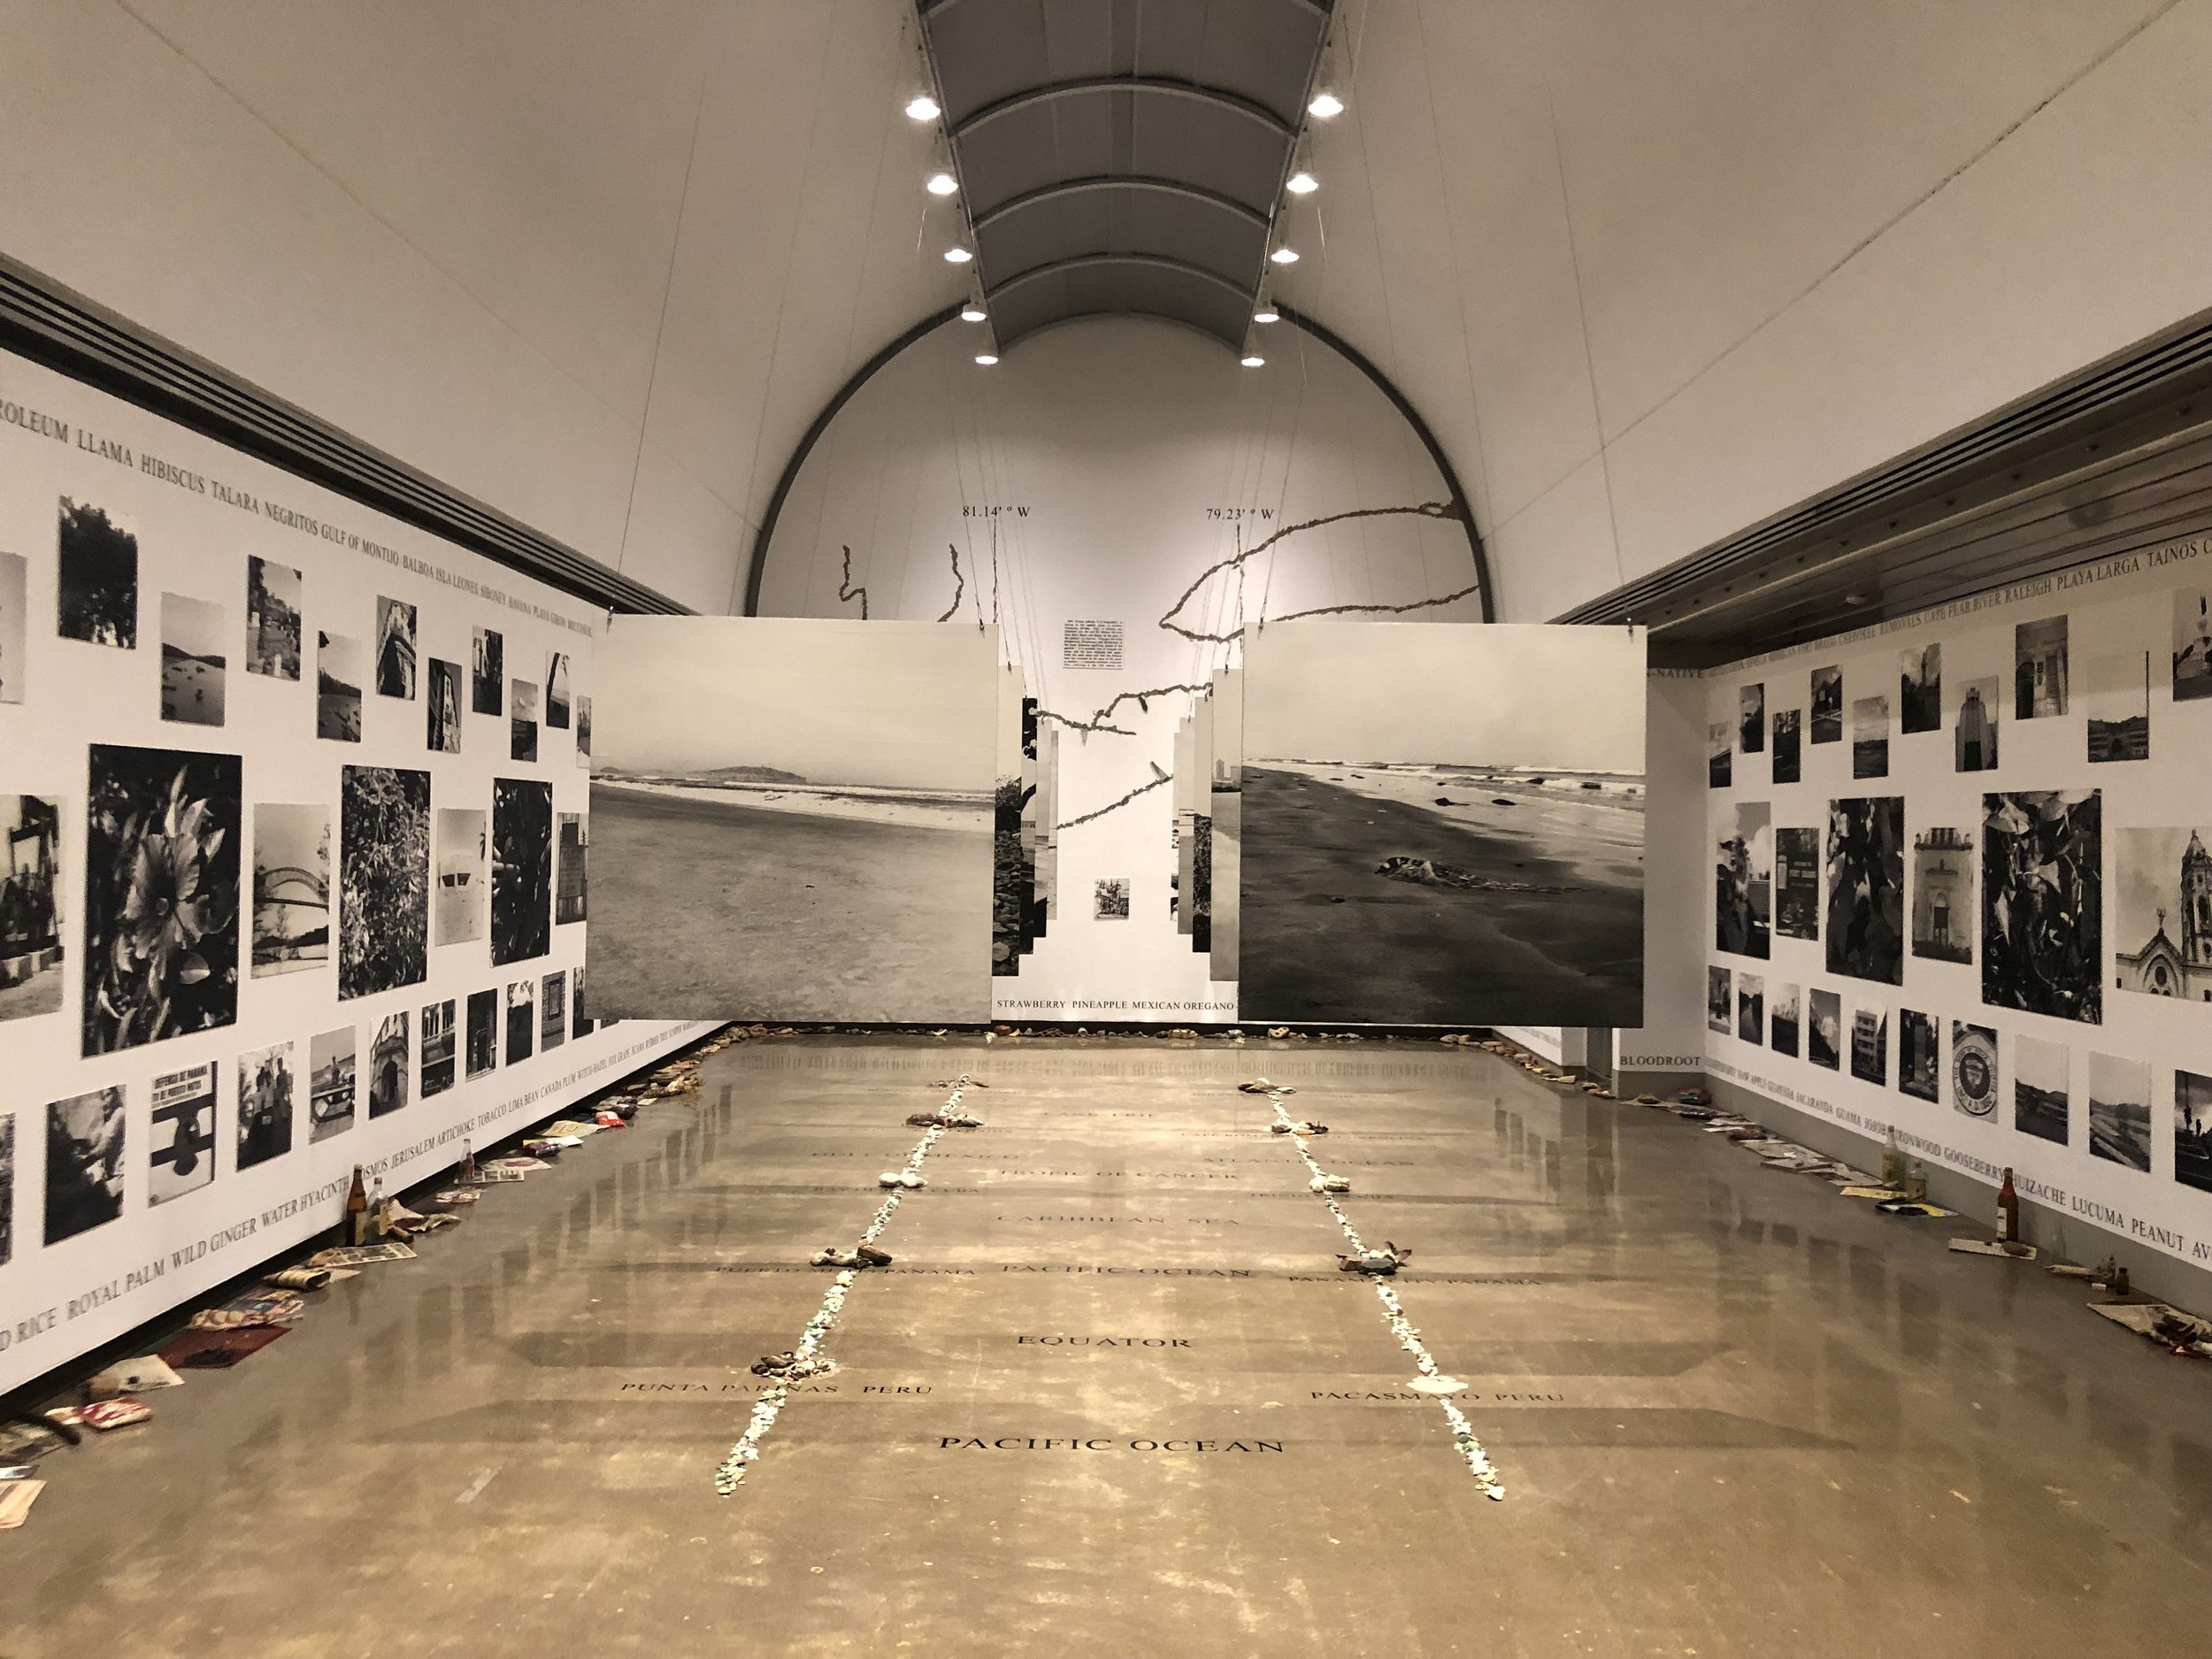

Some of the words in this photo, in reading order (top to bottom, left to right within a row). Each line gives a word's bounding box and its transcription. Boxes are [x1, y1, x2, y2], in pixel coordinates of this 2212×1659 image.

[0, 400, 68, 443] OLEUM
[78, 429, 134, 467] LLAMA
[142, 454, 206, 494] HIBISCUS
[211, 480, 259, 515] TALARA
[265, 501, 319, 535] NEGRITOS
[321, 523, 347, 545] GULF
[349, 534, 360, 550] OF
[403, 555, 434, 580] BALBOA
[435, 567, 452, 585] ISLA
[453, 575, 479, 595] LEONES
[1018, 507, 1031, 518] W
[1260, 509, 1274, 519] W
[1948, 601, 1970, 618] FEAR
[1973, 592, 2001, 611] RIVER
[2005, 579, 2051, 603] RALEIGH
[2057, 569, 2093, 591] PLAYA
[2096, 557, 2139, 580] LARGA
[2147, 541, 2198, 568] TAINOS
[996, 1000, 1066, 1009] STRAWBERRY
[1071, 1000, 1127, 1010] PINEAPPLE
[1132, 1001, 1180, 1010] MEXICAN
[1183, 1002, 1234, 1010] OREGANO
[1620, 1056, 1701, 1067] BLOODROOT
[1796, 1091, 1832, 1115] JACARANDA
[1835, 1106, 1862, 1126] GUAMA
[1864, 1117, 1886, 1135] JOJOB
[1896, 1128, 1941, 1157] IRONWOOD
[1944, 1147, 2004, 1182] GOOSEBERRY
[2013, 1173, 2066, 1206] HUIZACHE
[2072, 1195, 2124, 1229] LUCUMA
[2131, 1217, 2185, 1251] PEANUT
[16, 1307, 57, 1345] RICE
[66, 1280, 121, 1321] ROYAL
[127, 1258, 165, 1293] PALM
[172, 1240, 207, 1270] WILD
[210, 1217, 257, 1252] GINGER
[262, 1199, 298, 1228] WATER
[300, 1175, 349, 1211] HYACINTH
[363, 1158, 388, 1180] OSMOS
[390, 1137, 435, 1170] JERUSALEM
[436, 1118, 475, 1147] ARTICHOKE
[478, 1103, 507, 1127] TOBACCO
[509, 1097, 523, 1113] LIMA
[524, 1089, 539, 1106] BEAN
[541, 1080, 563, 1098] CANADA
[563, 1072, 576, 1087] PLUM
[577, 1058, 608, 1079] WITCH-HAZEL
[1002, 1265, 1127, 1274] PACIFIC
[1139, 1268, 1251, 1277] OCEAN
[1018, 1335, 1194, 1348] EQUATOR
[621, 1383, 709, 1392] PUNTA
[863, 1386, 933, 1394] PERU
[1310, 1391, 1480, 1401] PACASMAYO
[939, 1437, 1113, 1451] PACIFIC
[1130, 1439, 1284, 1453] OCEAN
